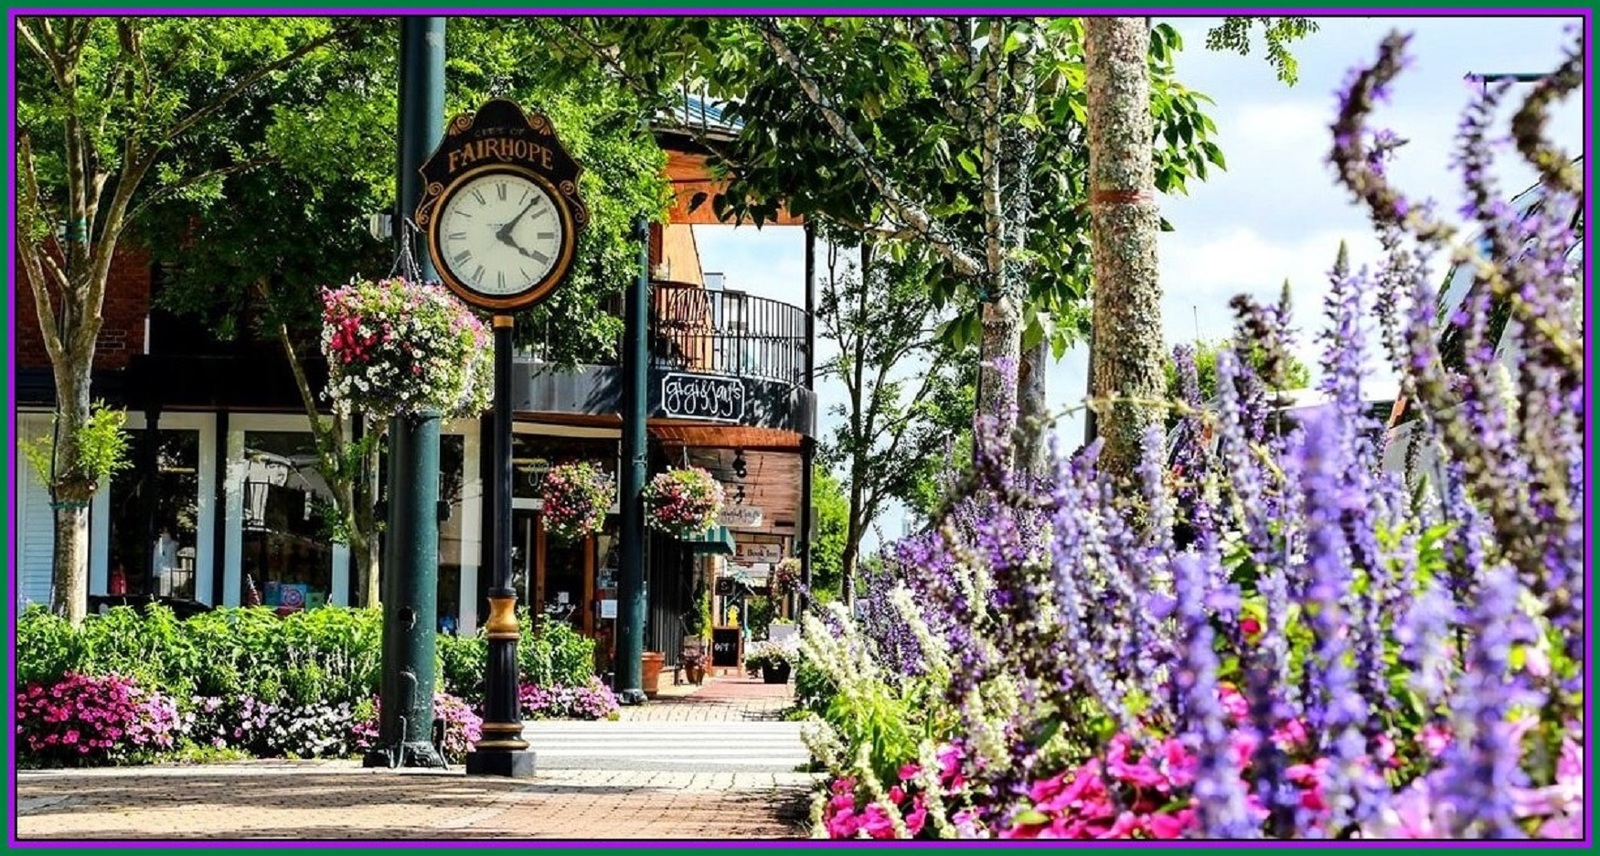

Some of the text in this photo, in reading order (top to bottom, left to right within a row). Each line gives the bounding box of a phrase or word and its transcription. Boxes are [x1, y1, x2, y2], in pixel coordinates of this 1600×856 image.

[475, 127, 525, 137] CITY OF
[448, 138, 554, 172] FAIRHOPE
